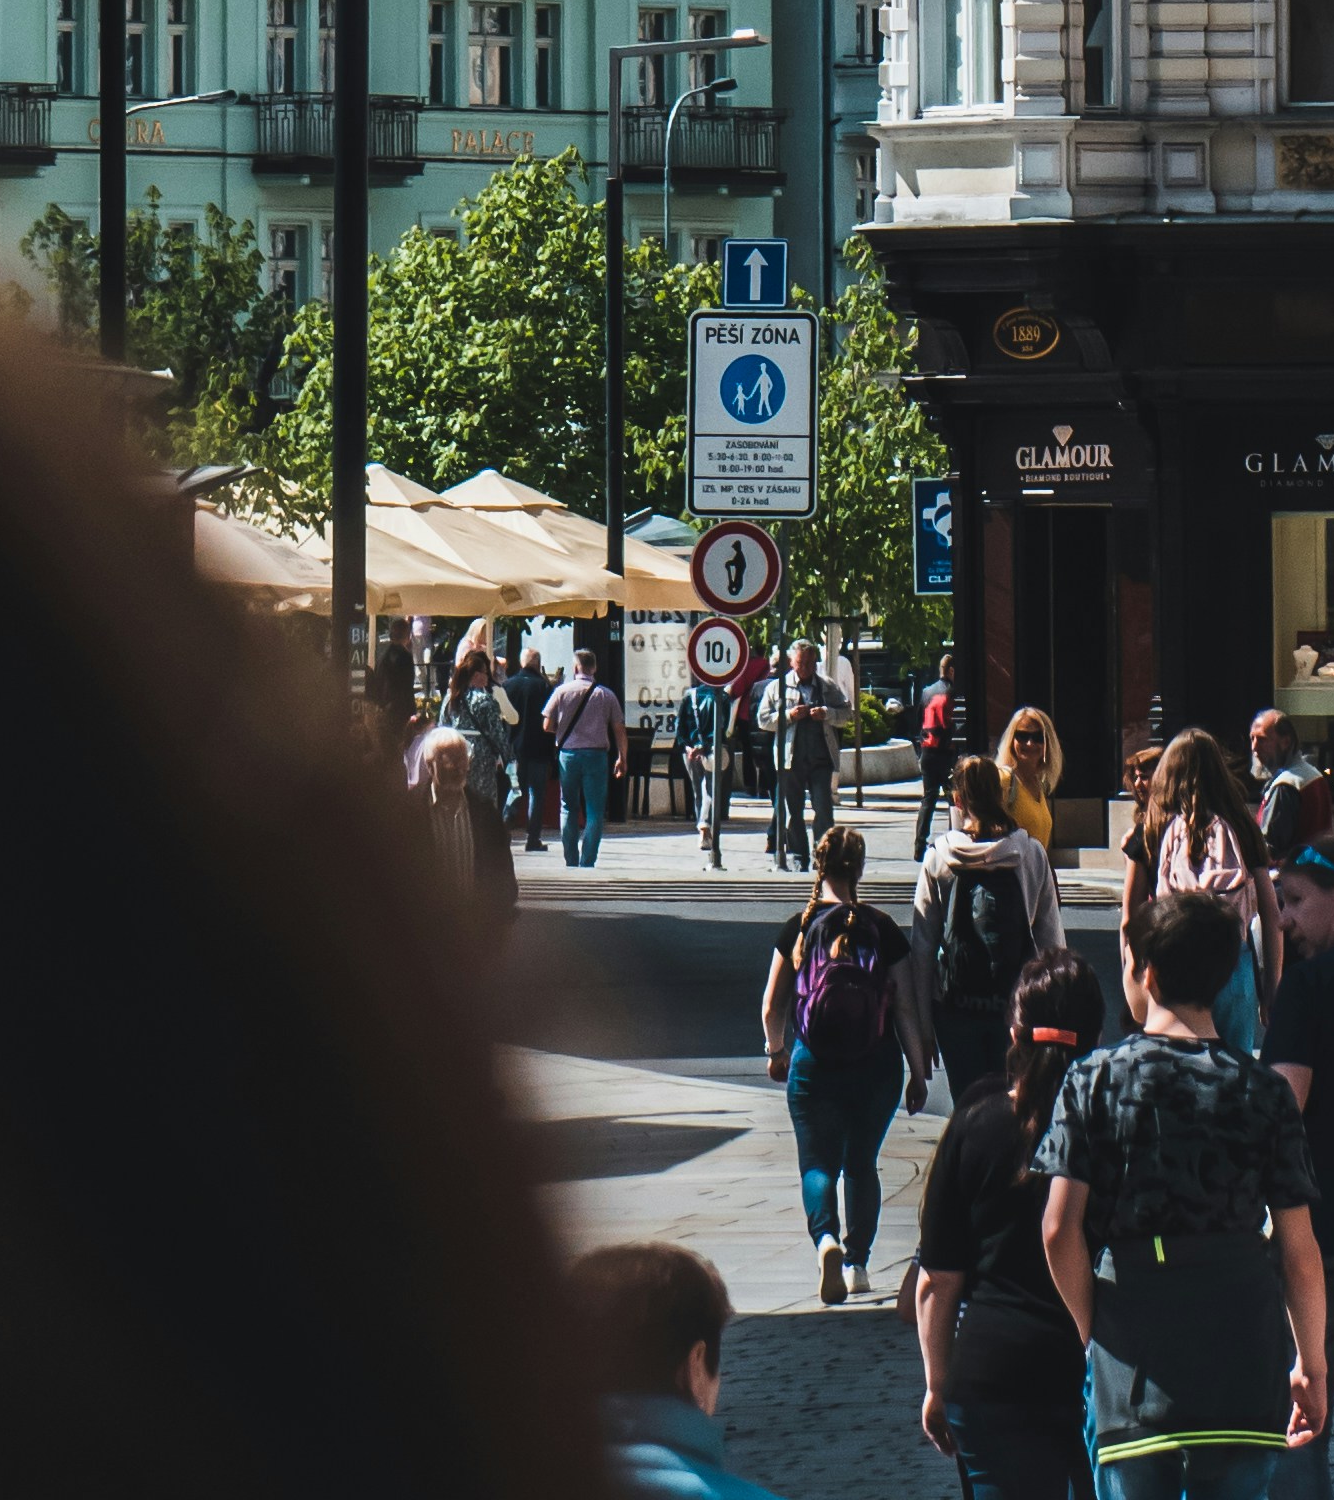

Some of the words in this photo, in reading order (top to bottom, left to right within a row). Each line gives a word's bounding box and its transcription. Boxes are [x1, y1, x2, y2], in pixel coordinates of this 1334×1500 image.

[451, 128, 535, 154] PALACE
[705, 323, 744, 345] PĚŠÍ
[751, 324, 801, 345] ZÓNA
[1012, 325, 1041, 342] 1889
[1015, 444, 1113, 470] GLAMOUR
[1025, 474, 1062, 482] DIAMOND
[1064, 472, 1104, 481] BOUTIQUE
[1260, 479, 1323, 488] DIAMOND
